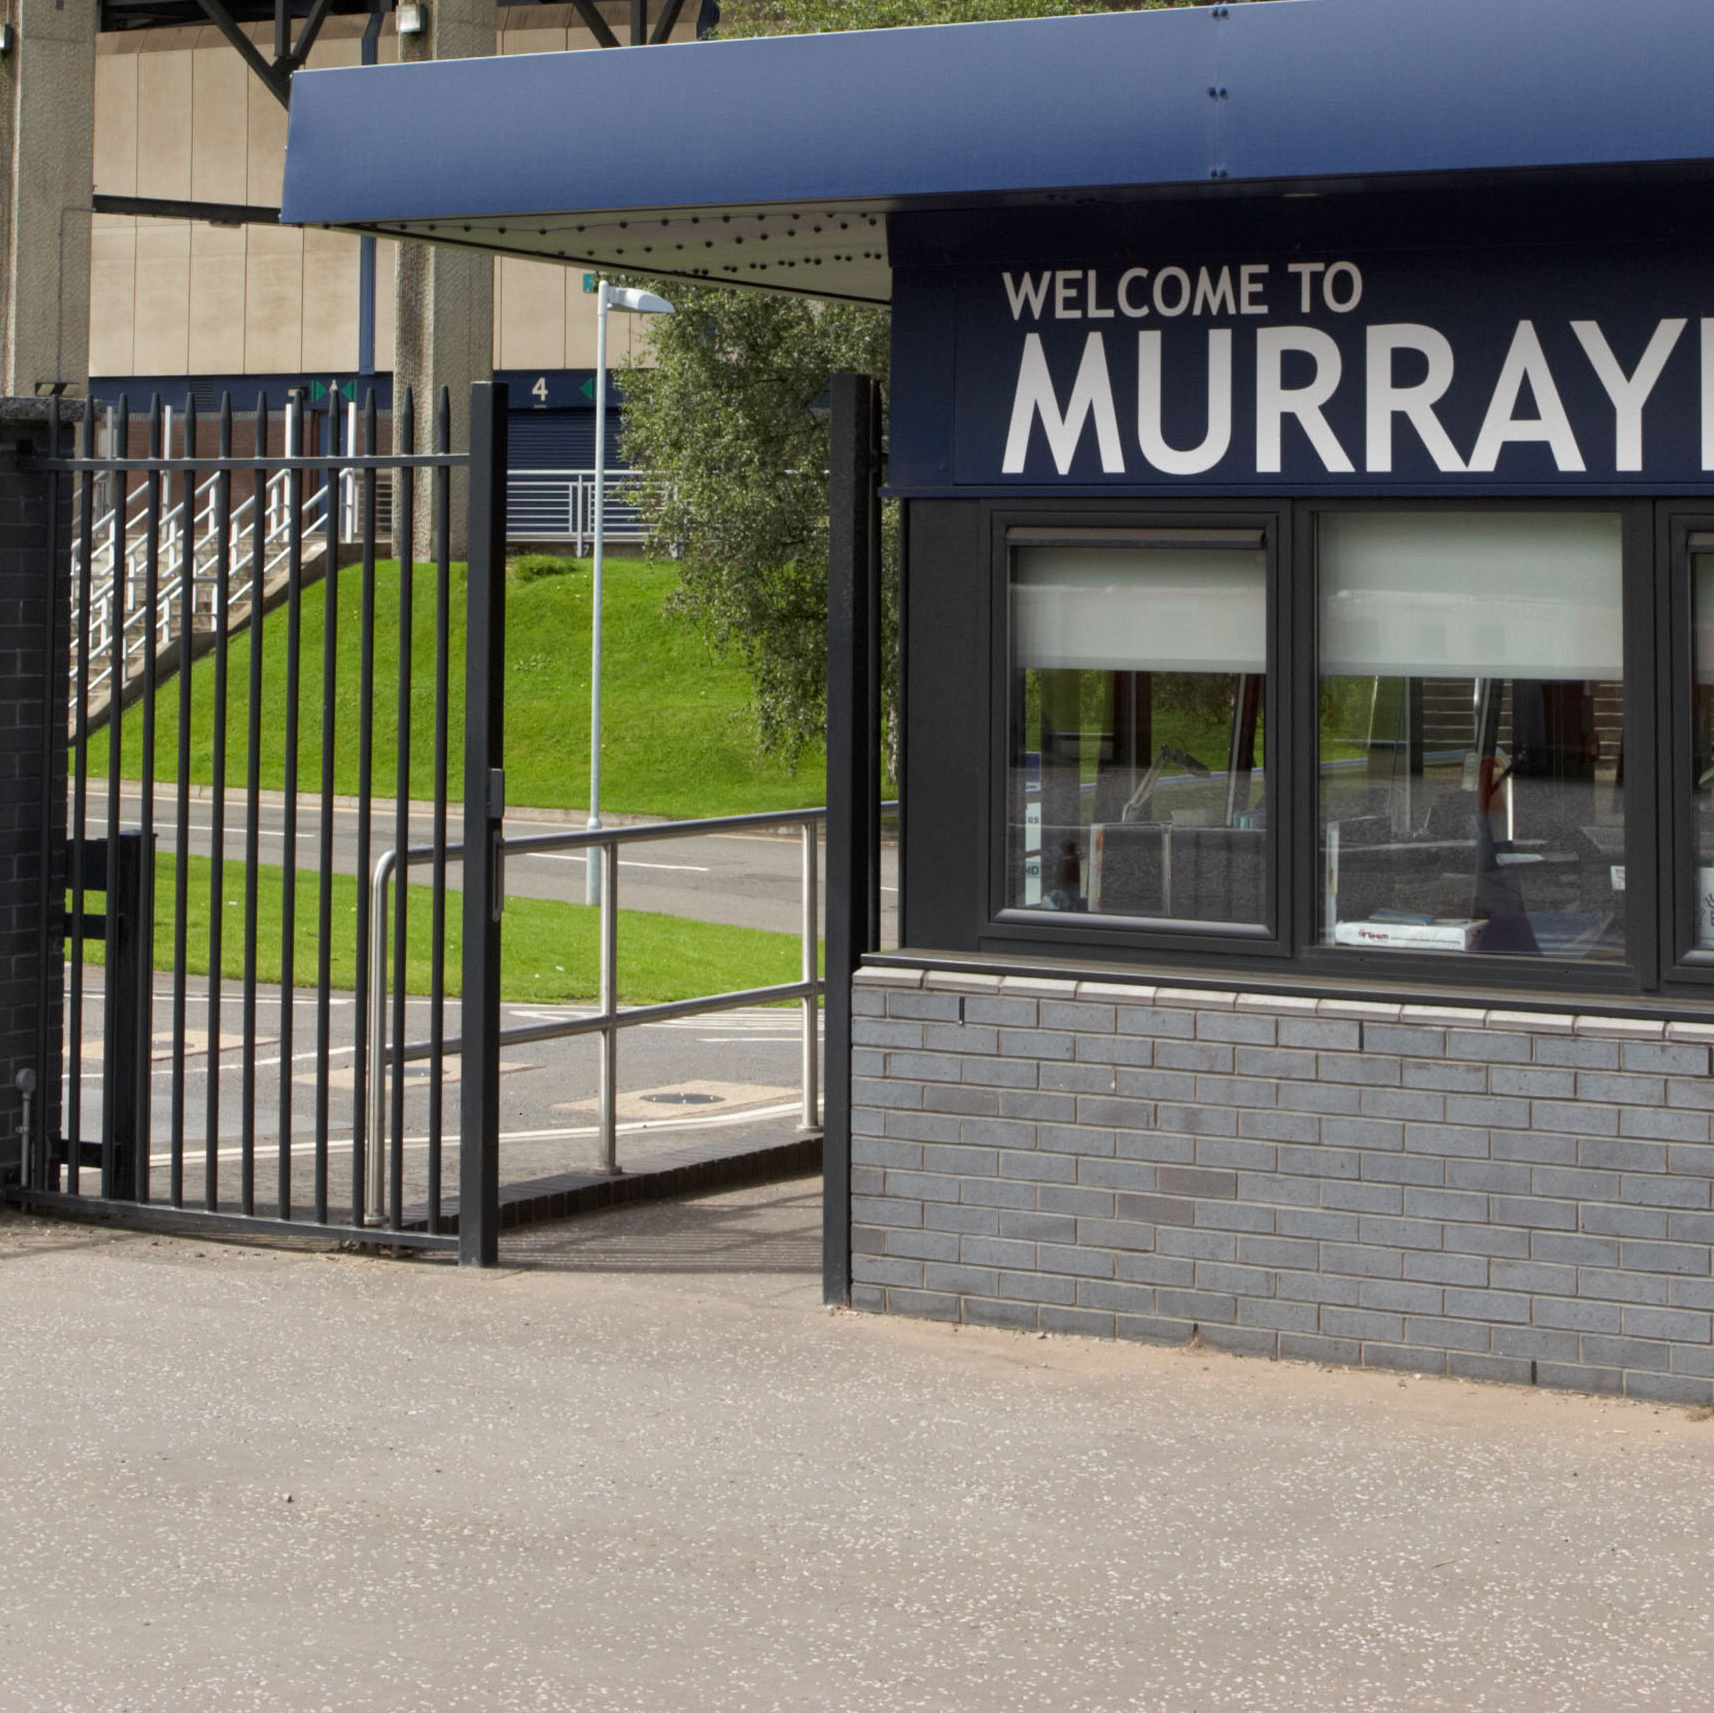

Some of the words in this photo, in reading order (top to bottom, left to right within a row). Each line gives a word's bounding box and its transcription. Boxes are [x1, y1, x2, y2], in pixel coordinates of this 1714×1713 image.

[1001, 263, 1270, 323] WELCOME
[1285, 259, 1364, 314] TO
[531, 377, 549, 402] 4
